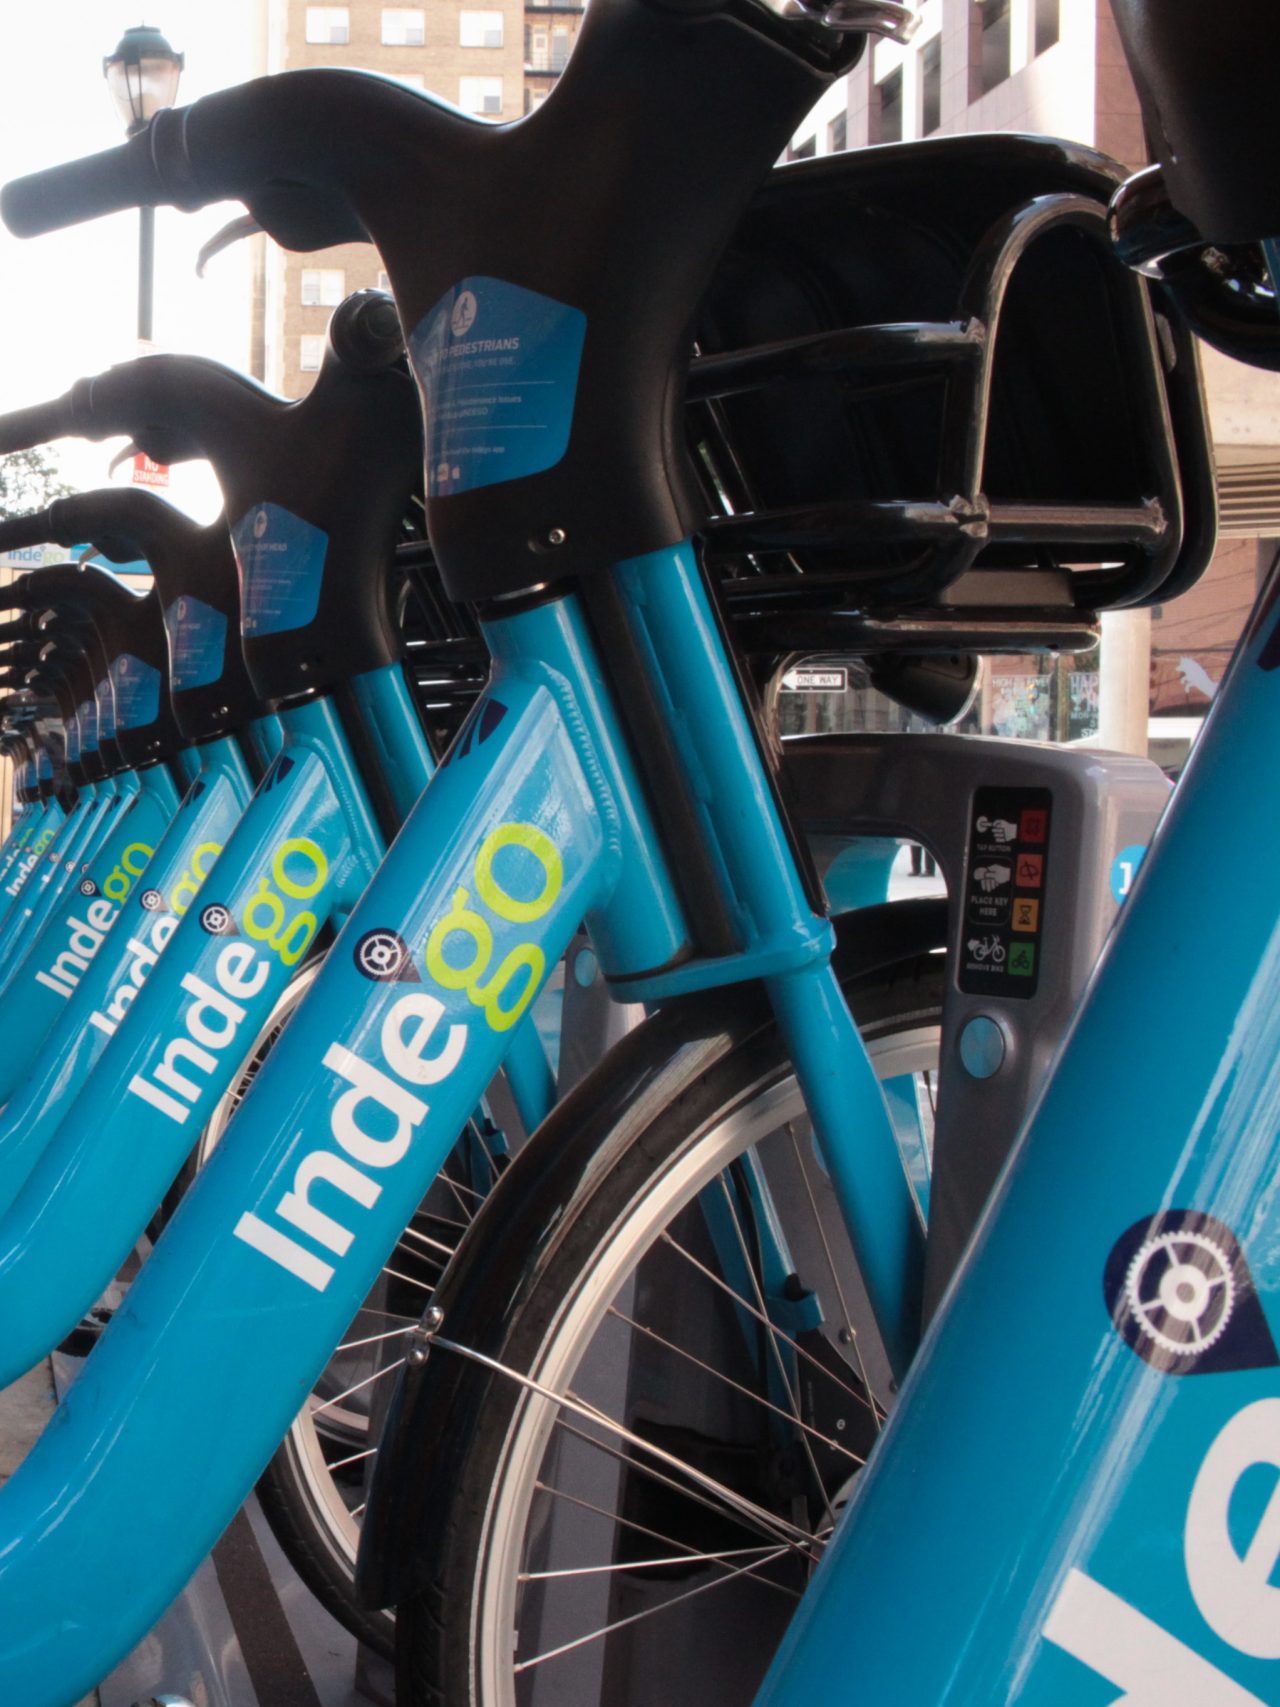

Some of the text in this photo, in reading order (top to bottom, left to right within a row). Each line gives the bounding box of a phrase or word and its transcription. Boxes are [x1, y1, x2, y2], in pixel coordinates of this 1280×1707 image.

[450, 338, 519, 357] PEDESTRIANS
[144, 456, 160, 472] NO
[134, 470, 169, 485] STANDING
[797, 675, 838, 685] ONE WAY
[971, 895, 1009, 906] PLACE KEY
[979, 907, 998, 917] HERE
[990, 964, 1005, 973] BIKE
[128, 838, 328, 1125] Indego
[233, 823, 563, 1293] Indego
